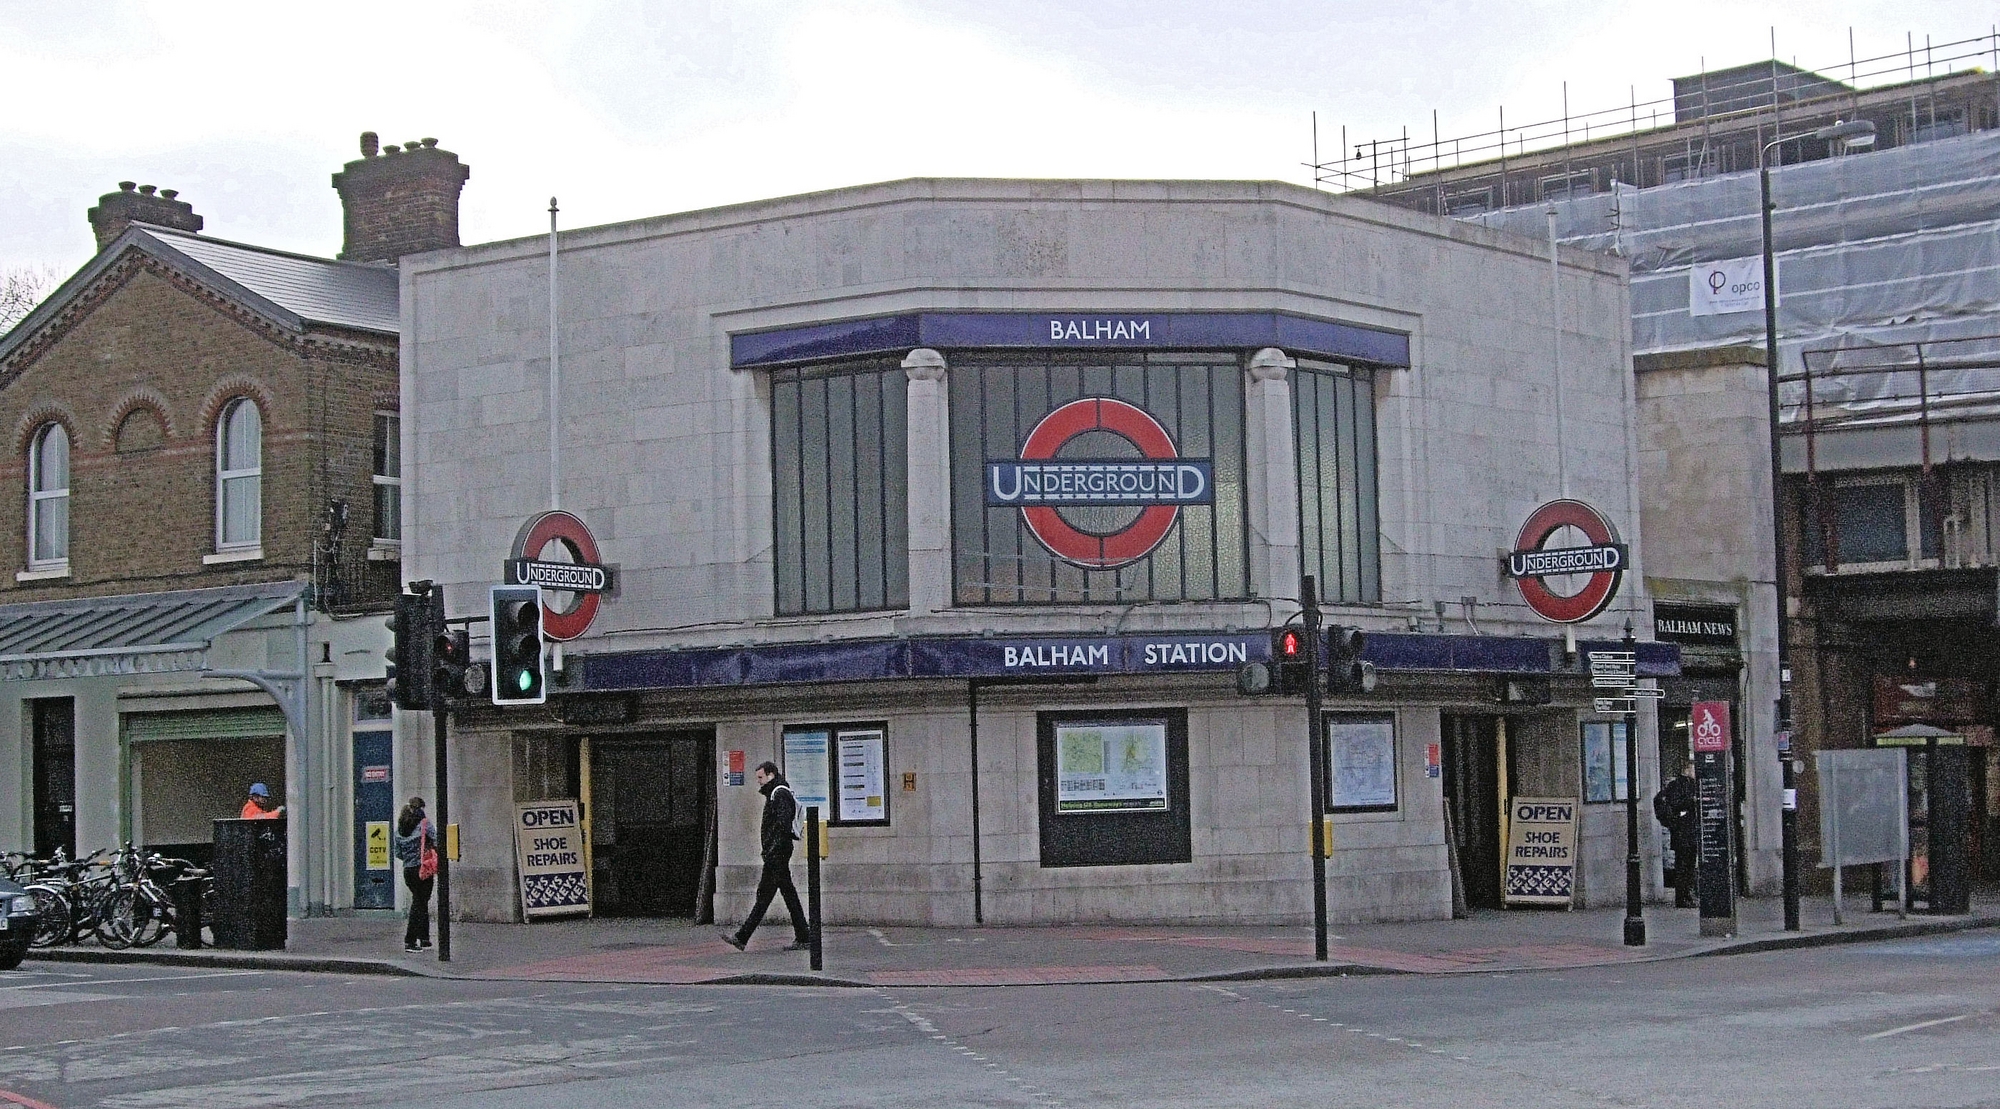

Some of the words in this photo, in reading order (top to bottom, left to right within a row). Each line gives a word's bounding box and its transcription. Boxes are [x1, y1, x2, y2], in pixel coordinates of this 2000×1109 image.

[1731, 281, 1760, 295] opco
[1050, 320, 1149, 339] BALHAM
[992, 465, 1205, 500] UNDERGROUND
[1510, 547, 1620, 576] UNDERGROUND
[516, 561, 605, 590] UNDERGROUND
[1658, 619, 1701, 634] BALHAM
[1703, 621, 1732, 636] NEWS
[1004, 645, 1109, 667] BALHAM
[1144, 642, 1246, 664] STATION
[1697, 736, 1721, 746] CYCLE
[522, 809, 574, 827] OPEN
[1517, 806, 1572, 821] OPEN
[534, 837, 568, 851] SHOE
[1525, 831, 1561, 844] SHOE
[369, 846, 387, 854] CCTV
[1515, 846, 1568, 858] REPAIRS
[527, 852, 577, 867] REPAIRS
[527, 876, 548, 907] KEYS
[540, 875, 563, 906] KEYS
[554, 874, 577, 904] KEYS
